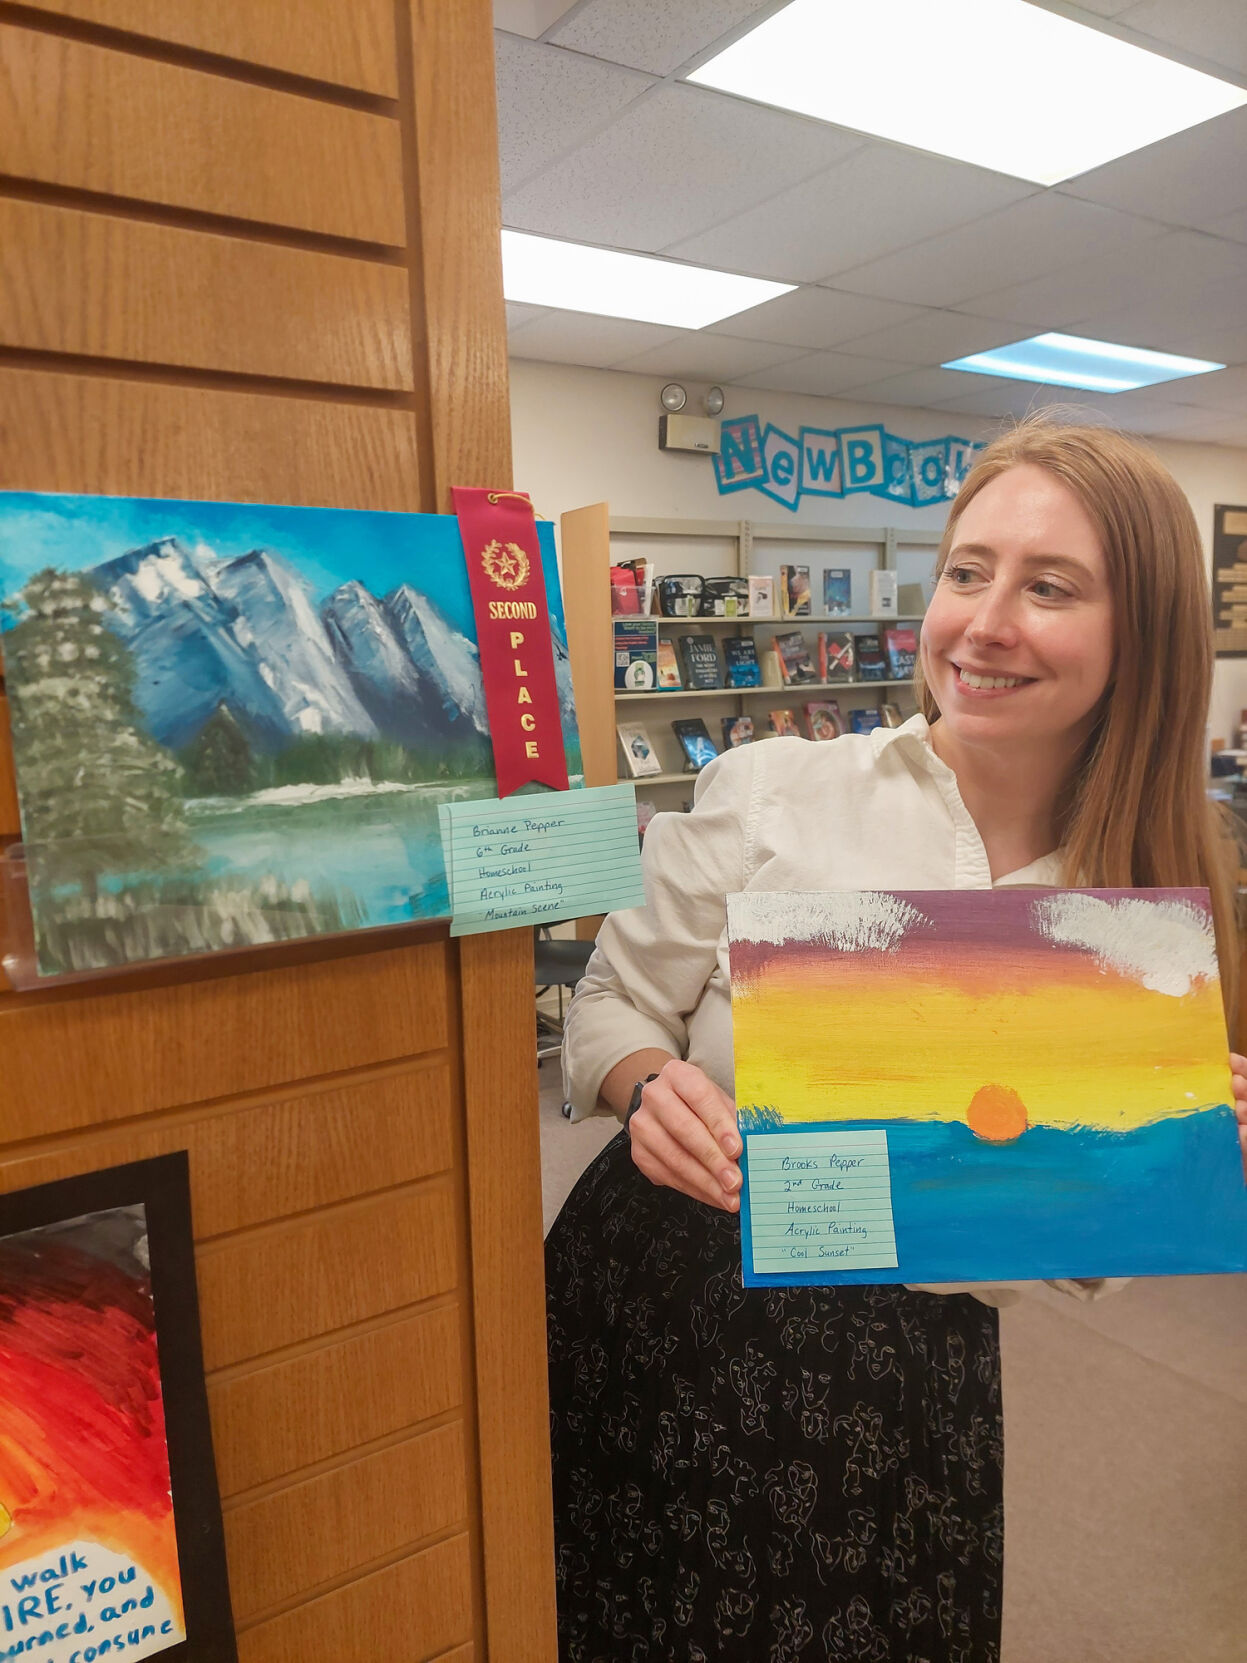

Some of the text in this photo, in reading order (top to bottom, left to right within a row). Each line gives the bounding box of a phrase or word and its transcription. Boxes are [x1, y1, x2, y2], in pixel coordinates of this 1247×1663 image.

[720, 425, 838, 487] New
[488, 601, 537, 620] SECOND
[510, 631, 540, 759] PLACE
[473, 818, 565, 837] Brianne Pepper
[476, 843, 531, 858] 6th Grade
[479, 863, 531, 879] Homeschool
[480, 880, 563, 901] Acrylic Painting
[781, 1153, 865, 1173] Brooks Pepper
[783, 1178, 844, 1193] 2nd Grade
[787, 1201, 841, 1214] Homeschool
[785, 1221, 868, 1240] Acrylic Painting
[10, 1551, 88, 1593] walk
[80, 1566, 136, 1603] you
[100, 1585, 155, 1622] and
